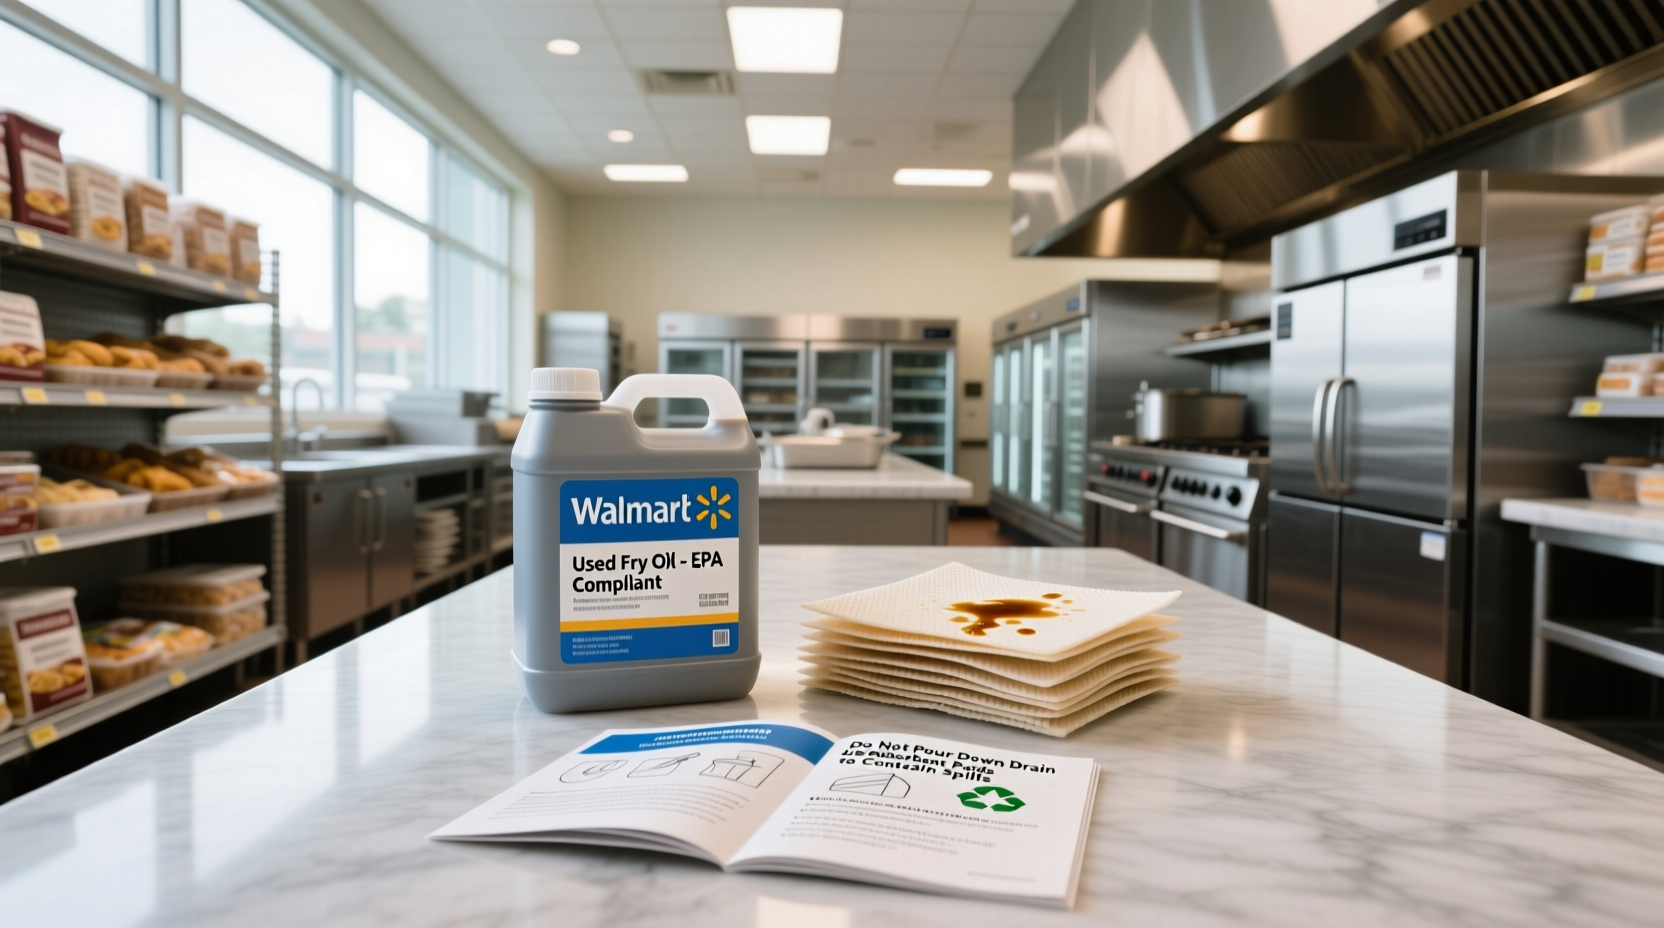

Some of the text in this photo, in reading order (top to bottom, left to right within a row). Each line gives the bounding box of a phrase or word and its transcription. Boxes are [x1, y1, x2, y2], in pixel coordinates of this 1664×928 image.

[571, 494, 691, 525] Walmart
[572, 554, 616, 572] Used
[621, 554, 649, 575] Fry
[691, 550, 724, 569] EPA
[850, 740, 1056, 774] Do Not Pour Down Drain
